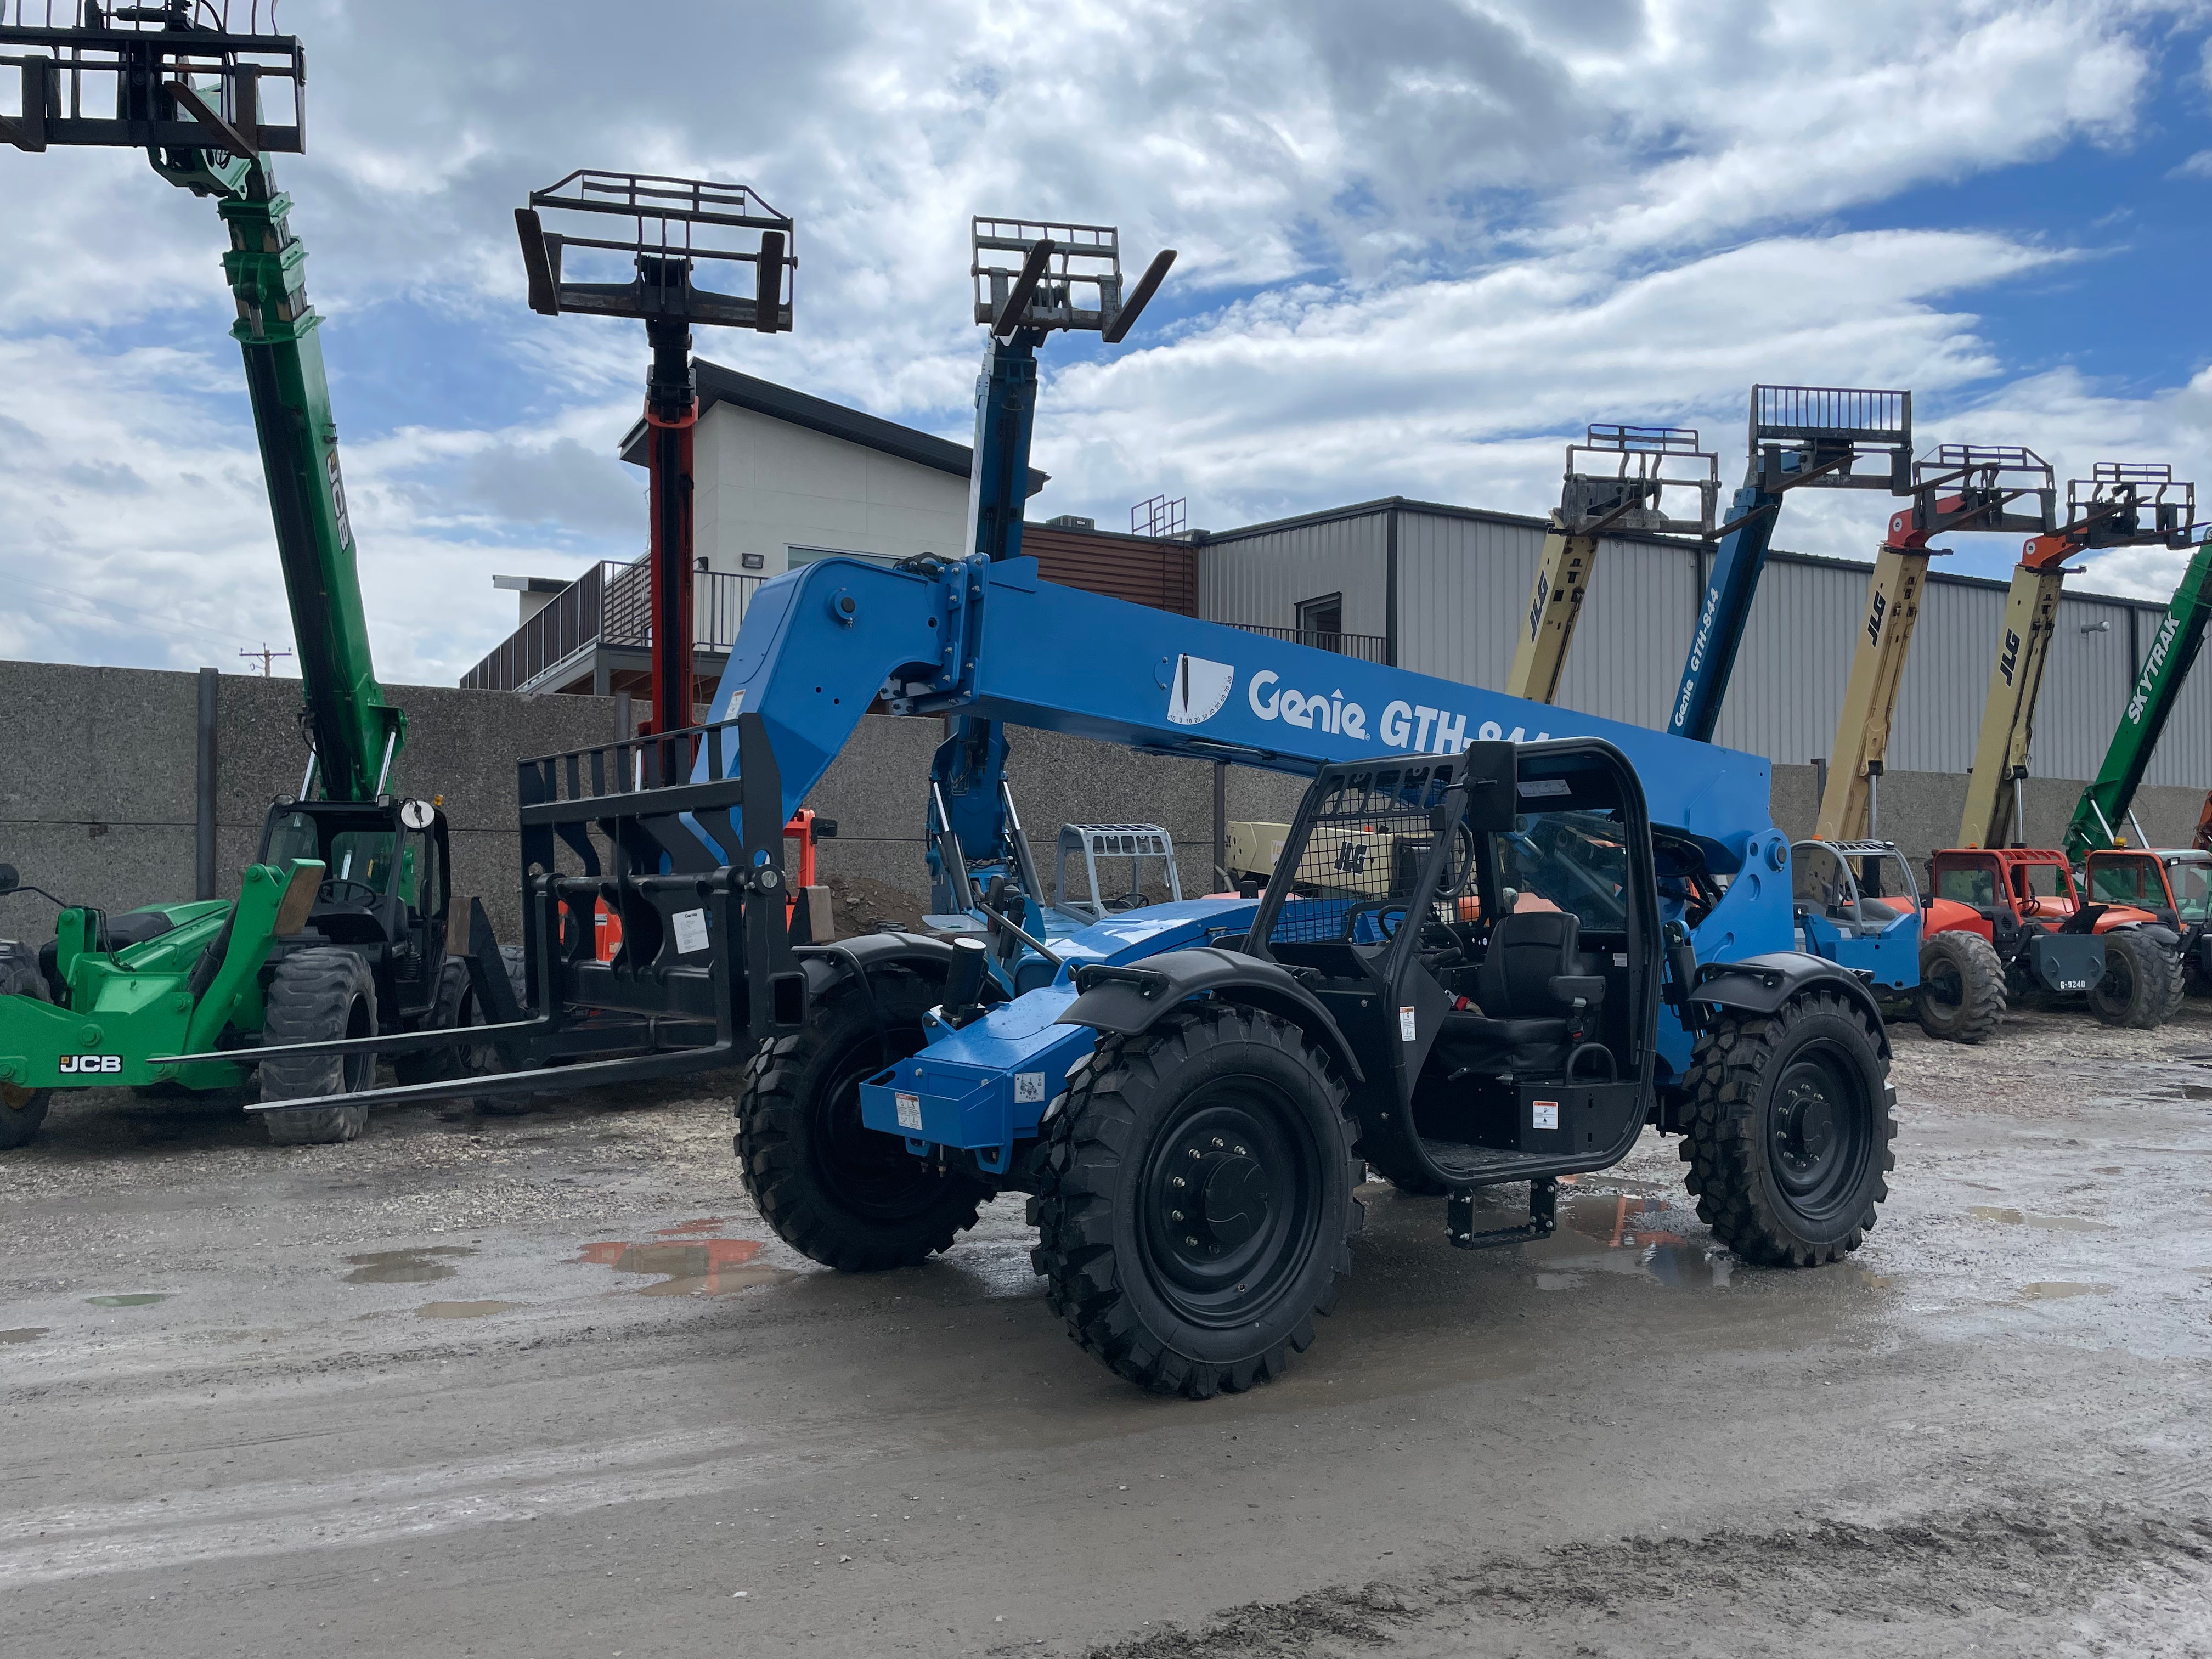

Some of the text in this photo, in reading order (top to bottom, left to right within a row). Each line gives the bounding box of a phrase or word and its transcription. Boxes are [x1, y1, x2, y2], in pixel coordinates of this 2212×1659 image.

[328, 456, 349, 550] JCB
[1530, 568, 1549, 644] JLG
[1867, 590, 1886, 647] JLG
[1675, 587, 1719, 727] Genie GTH-844
[2000, 628, 2020, 687] JLG
[2128, 610, 2180, 725] SKYTRAK
[1248, 670, 1549, 754] Genie GTH-
[1334, 842, 1367, 874] JLG
[60, 1056, 121, 1073] JCB
